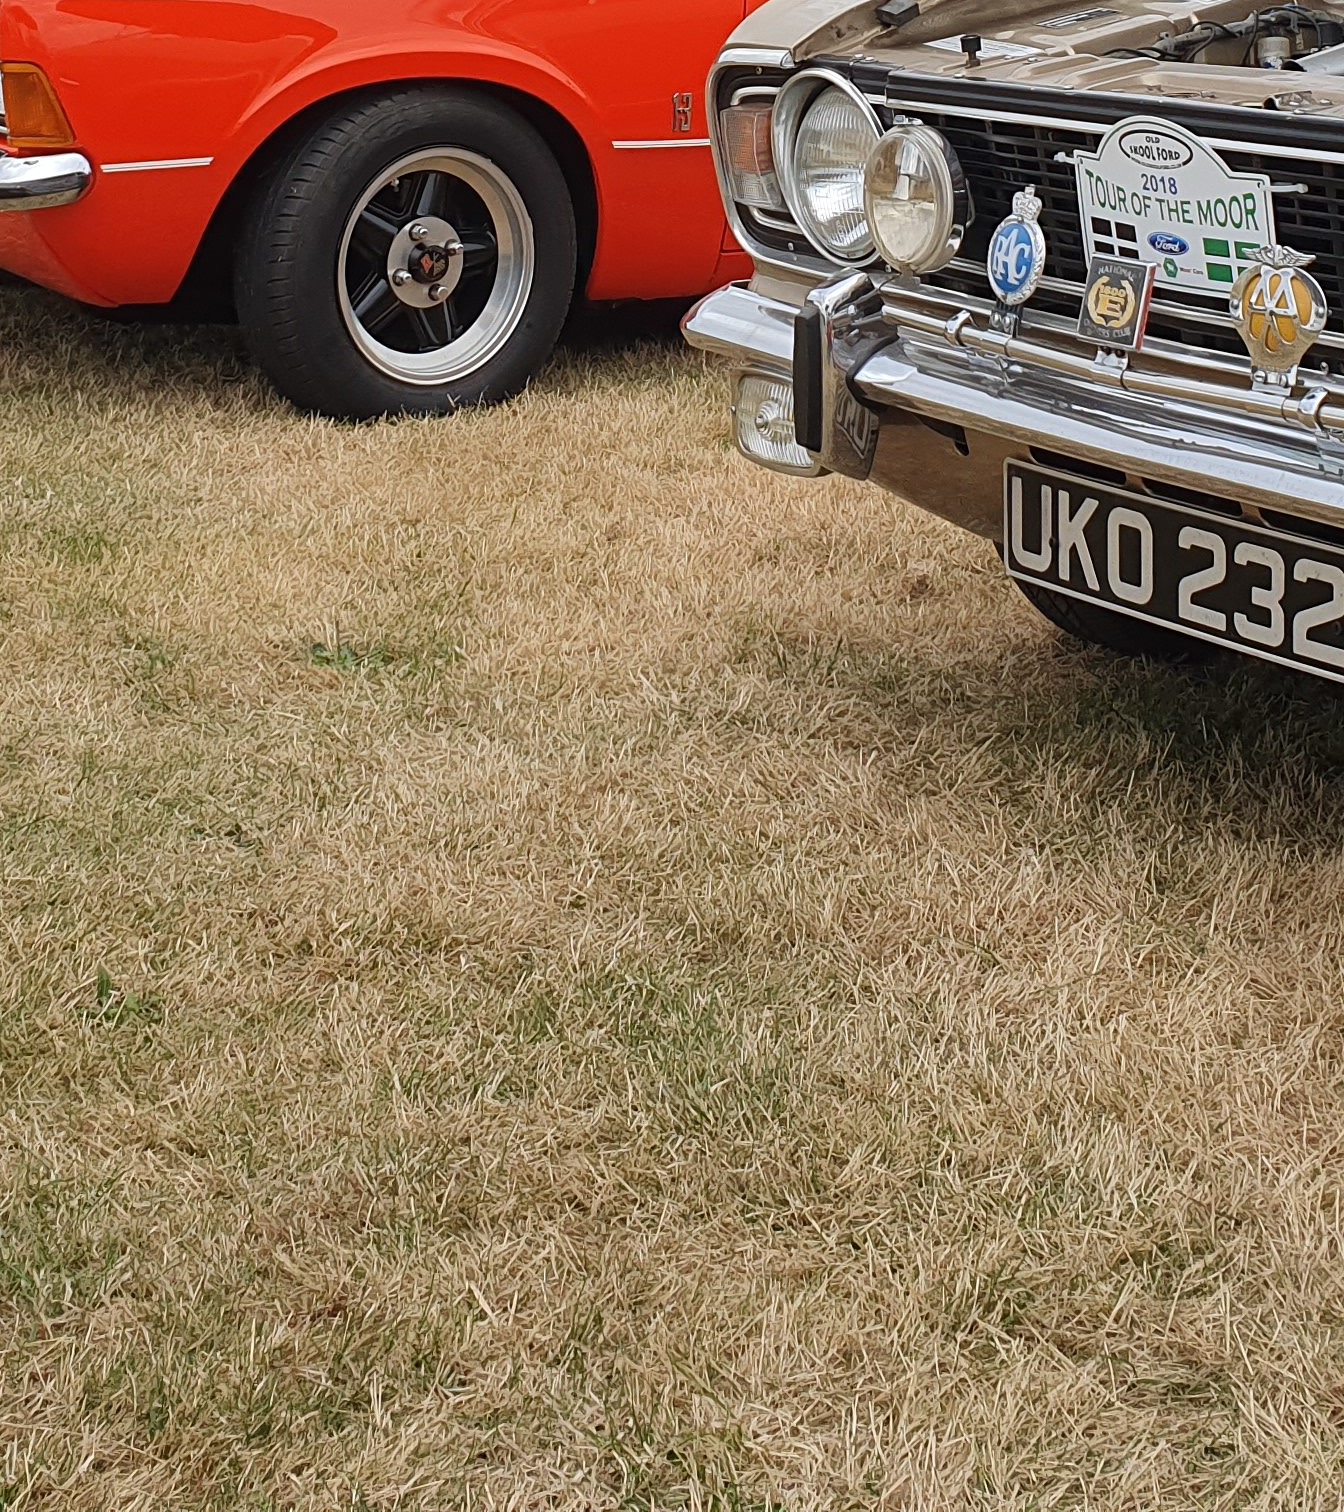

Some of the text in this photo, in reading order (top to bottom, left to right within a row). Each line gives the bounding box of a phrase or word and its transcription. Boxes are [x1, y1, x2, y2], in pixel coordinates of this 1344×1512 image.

[1145, 135, 1161, 144] OLD
[1156, 146, 1181, 161] FORD
[1085, 168, 1260, 232] TOUR OF THE MOOR
[1141, 173, 1179, 196] 2018
[992, 227, 1032, 286] RAC
[1095, 293, 1125, 319] E
[1248, 264, 1299, 318] AA
[1011, 475, 1154, 606] UKO
